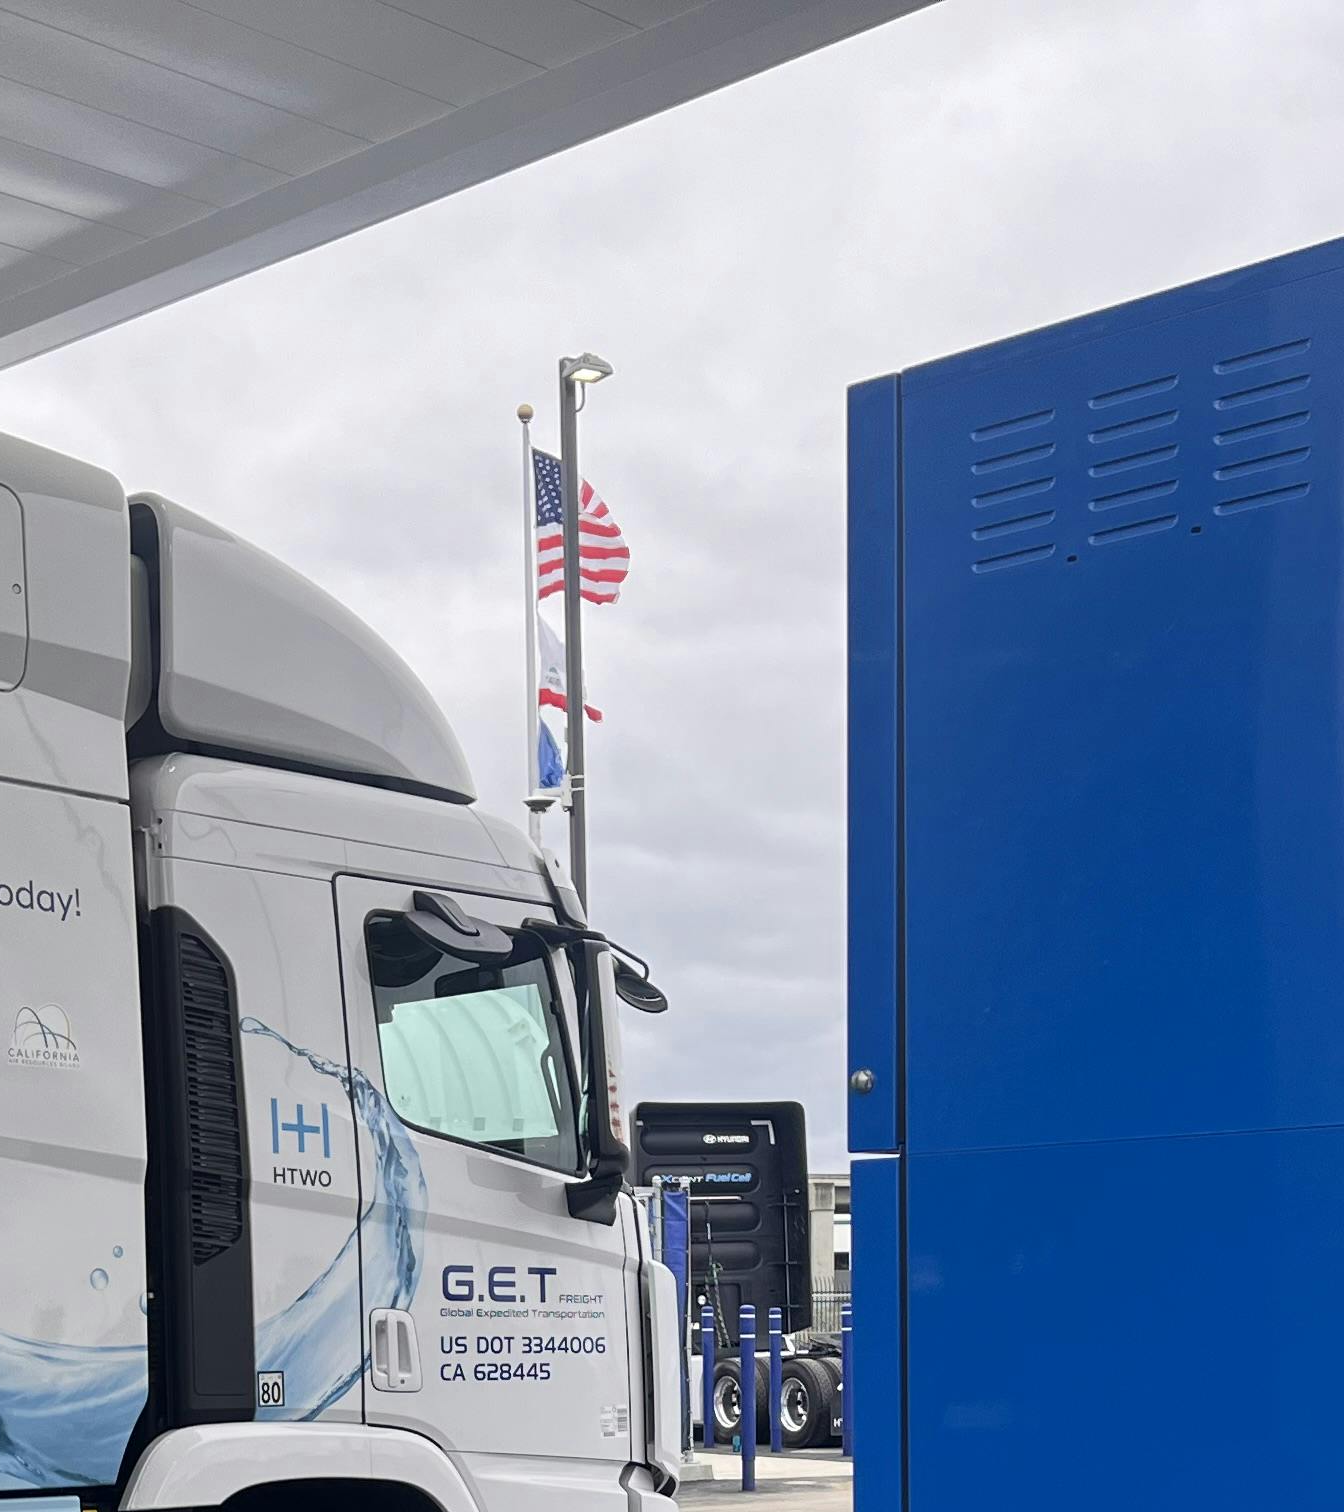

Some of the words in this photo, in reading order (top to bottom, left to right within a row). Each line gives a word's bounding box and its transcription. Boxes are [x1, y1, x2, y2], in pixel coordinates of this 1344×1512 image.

[7, 1047, 80, 1063] CALIFORNIA
[272, 1166, 332, 1188] HTWO
[705, 1173, 731, 1183] Fuel
[558, 1294, 604, 1305] FREIGHT
[440, 1307, 474, 1318] Global
[476, 1308, 529, 1320] Expedited
[532, 1308, 605, 1320] Transportation
[440, 1335, 468, 1354] US
[476, 1335, 515, 1354] DOT
[521, 1336, 606, 1354] 3344006
[440, 1362, 466, 1381] CA
[473, 1362, 552, 1381] 628445
[261, 1381, 281, 1404] 80
